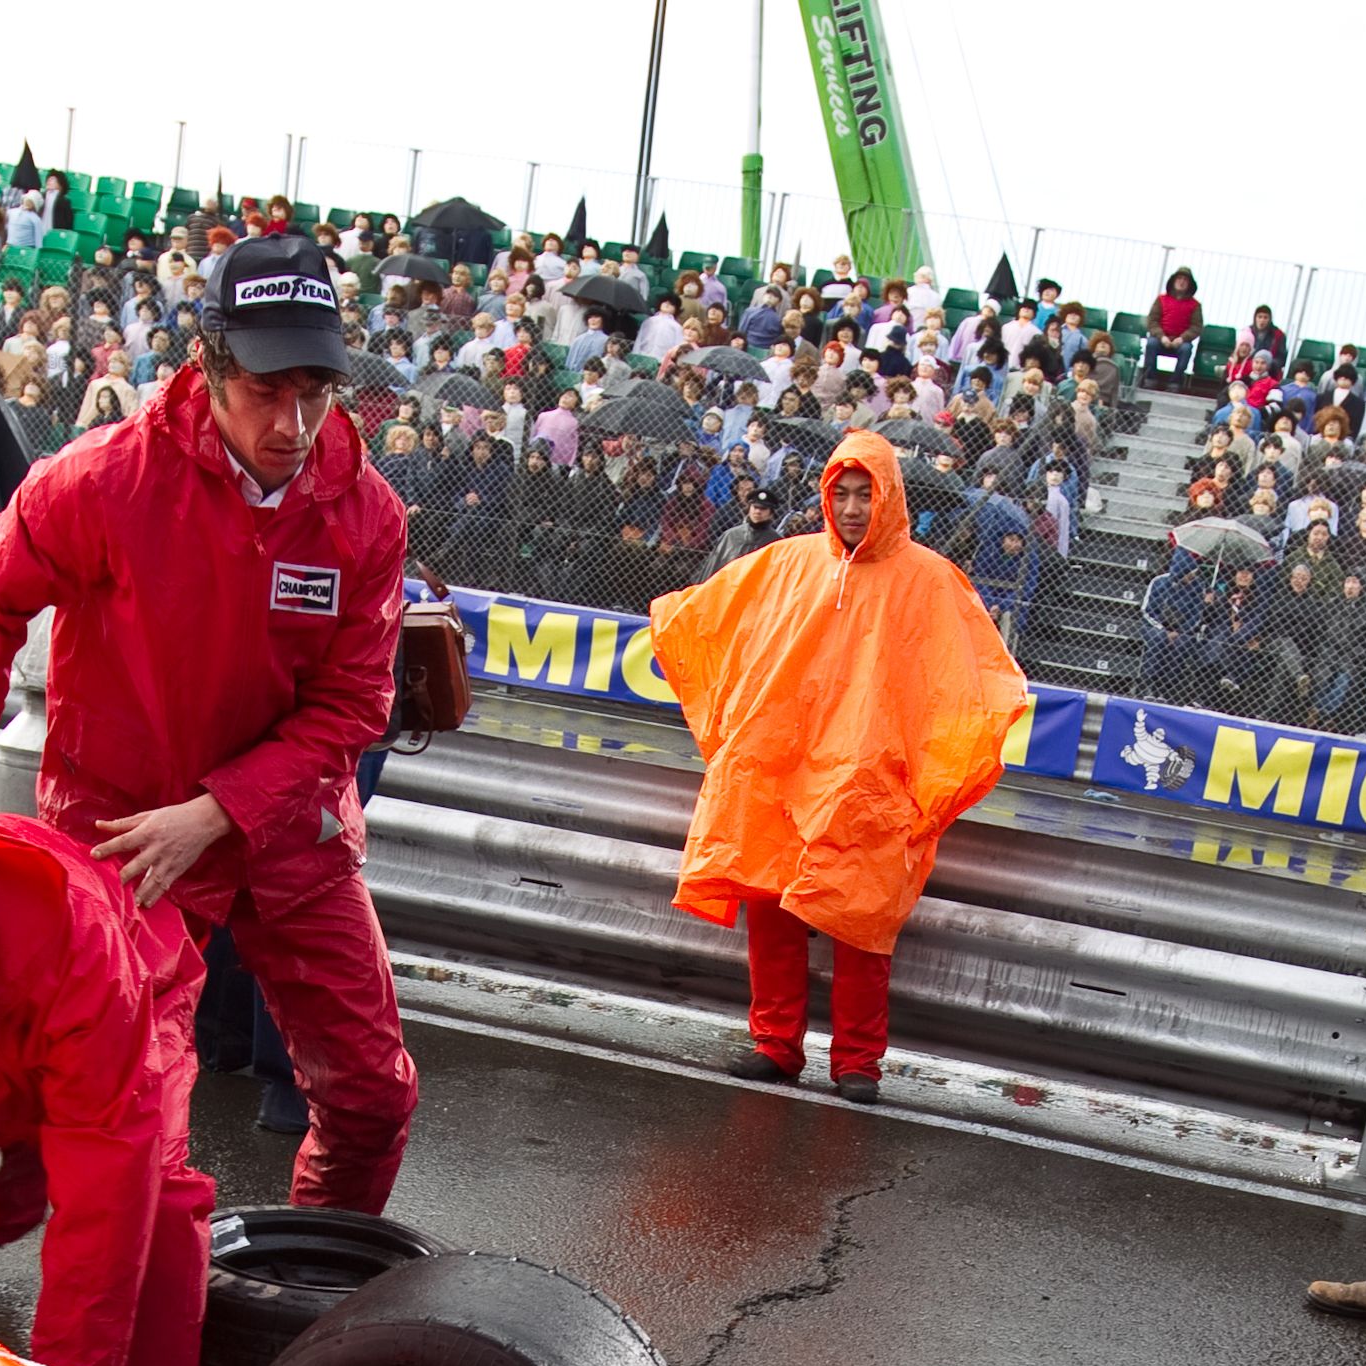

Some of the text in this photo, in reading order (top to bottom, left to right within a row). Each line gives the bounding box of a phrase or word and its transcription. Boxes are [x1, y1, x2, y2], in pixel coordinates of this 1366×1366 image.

[811, 15, 851, 138] Services
[832, 0, 887, 147] IFTING
[240, 276, 333, 302] GOODYEAR
[279, 580, 331, 598] CHAMPION
